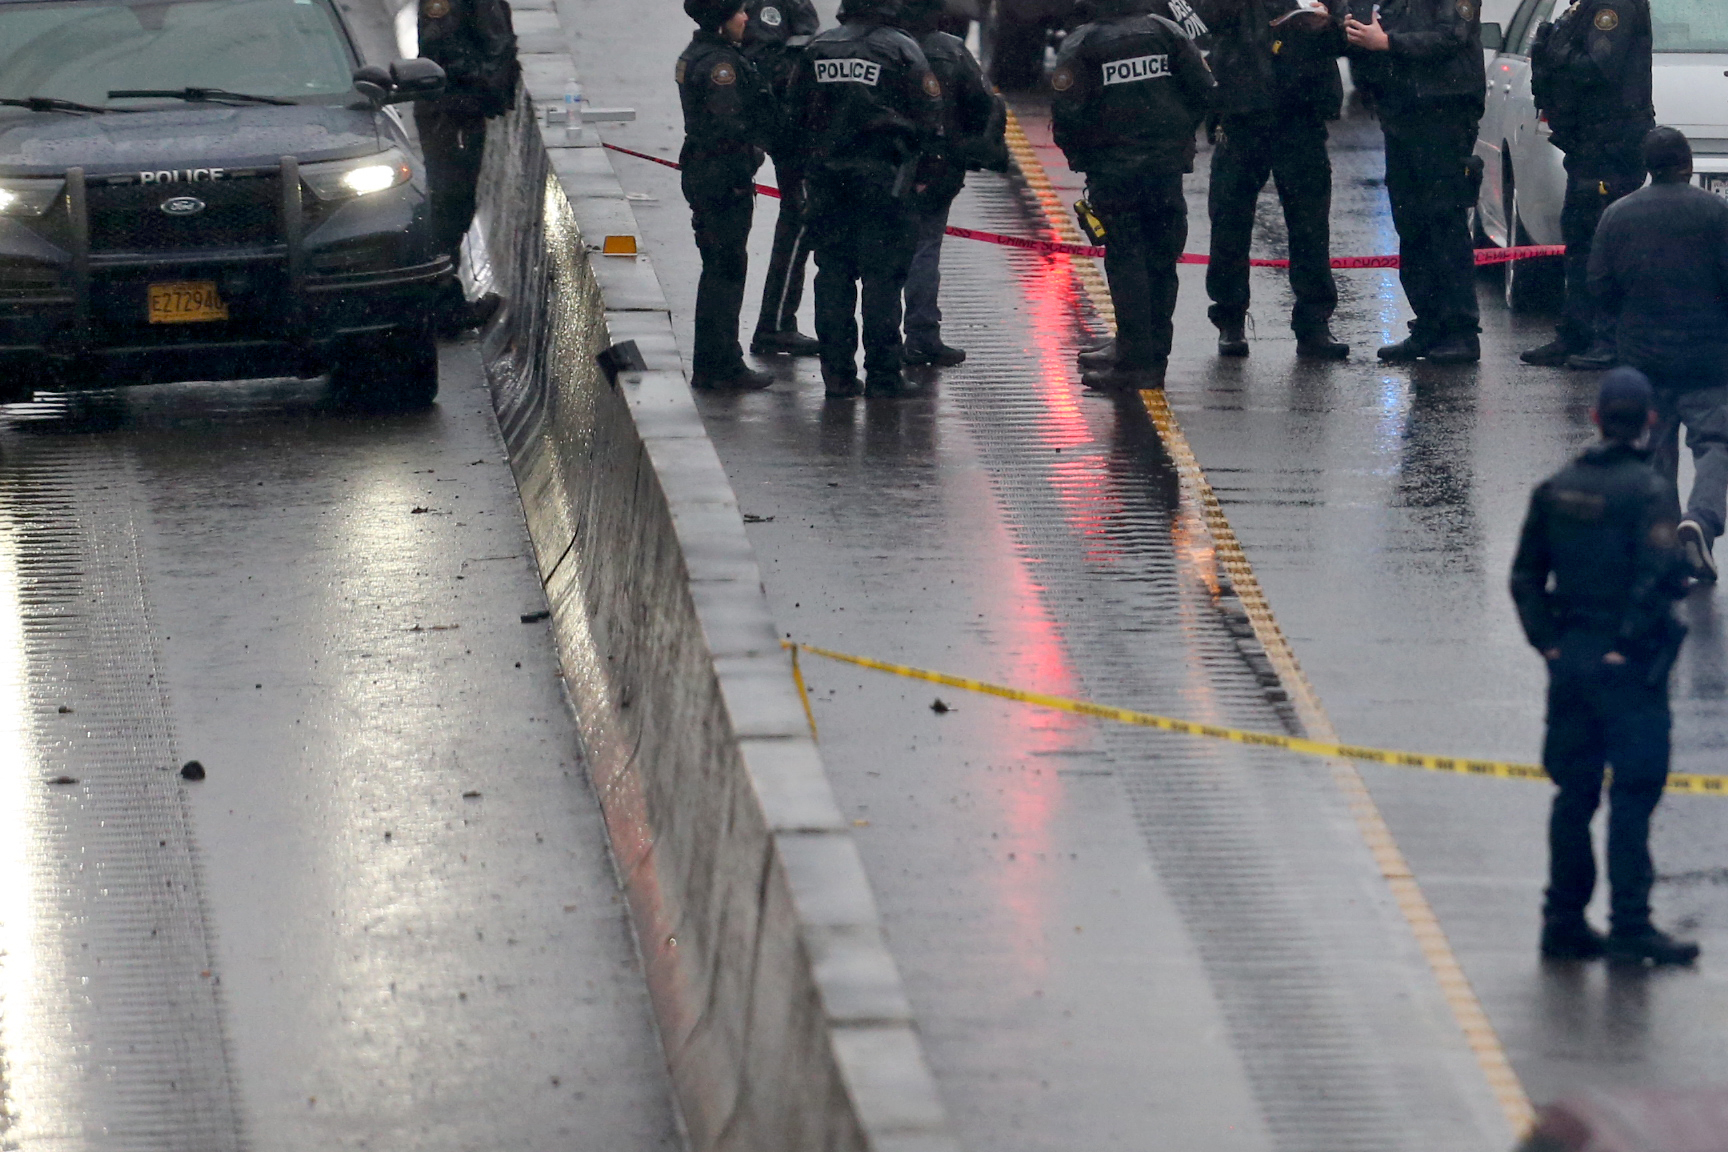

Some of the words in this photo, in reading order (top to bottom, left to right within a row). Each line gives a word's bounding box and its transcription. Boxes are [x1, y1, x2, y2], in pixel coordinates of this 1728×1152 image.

[817, 62, 877, 82] POLICE
[1105, 58, 1170, 83] POLICE
[140, 168, 224, 185] POLICE
[997, 234, 1037, 249] CRIME
[1041, 241, 1085, 255] SCENE
